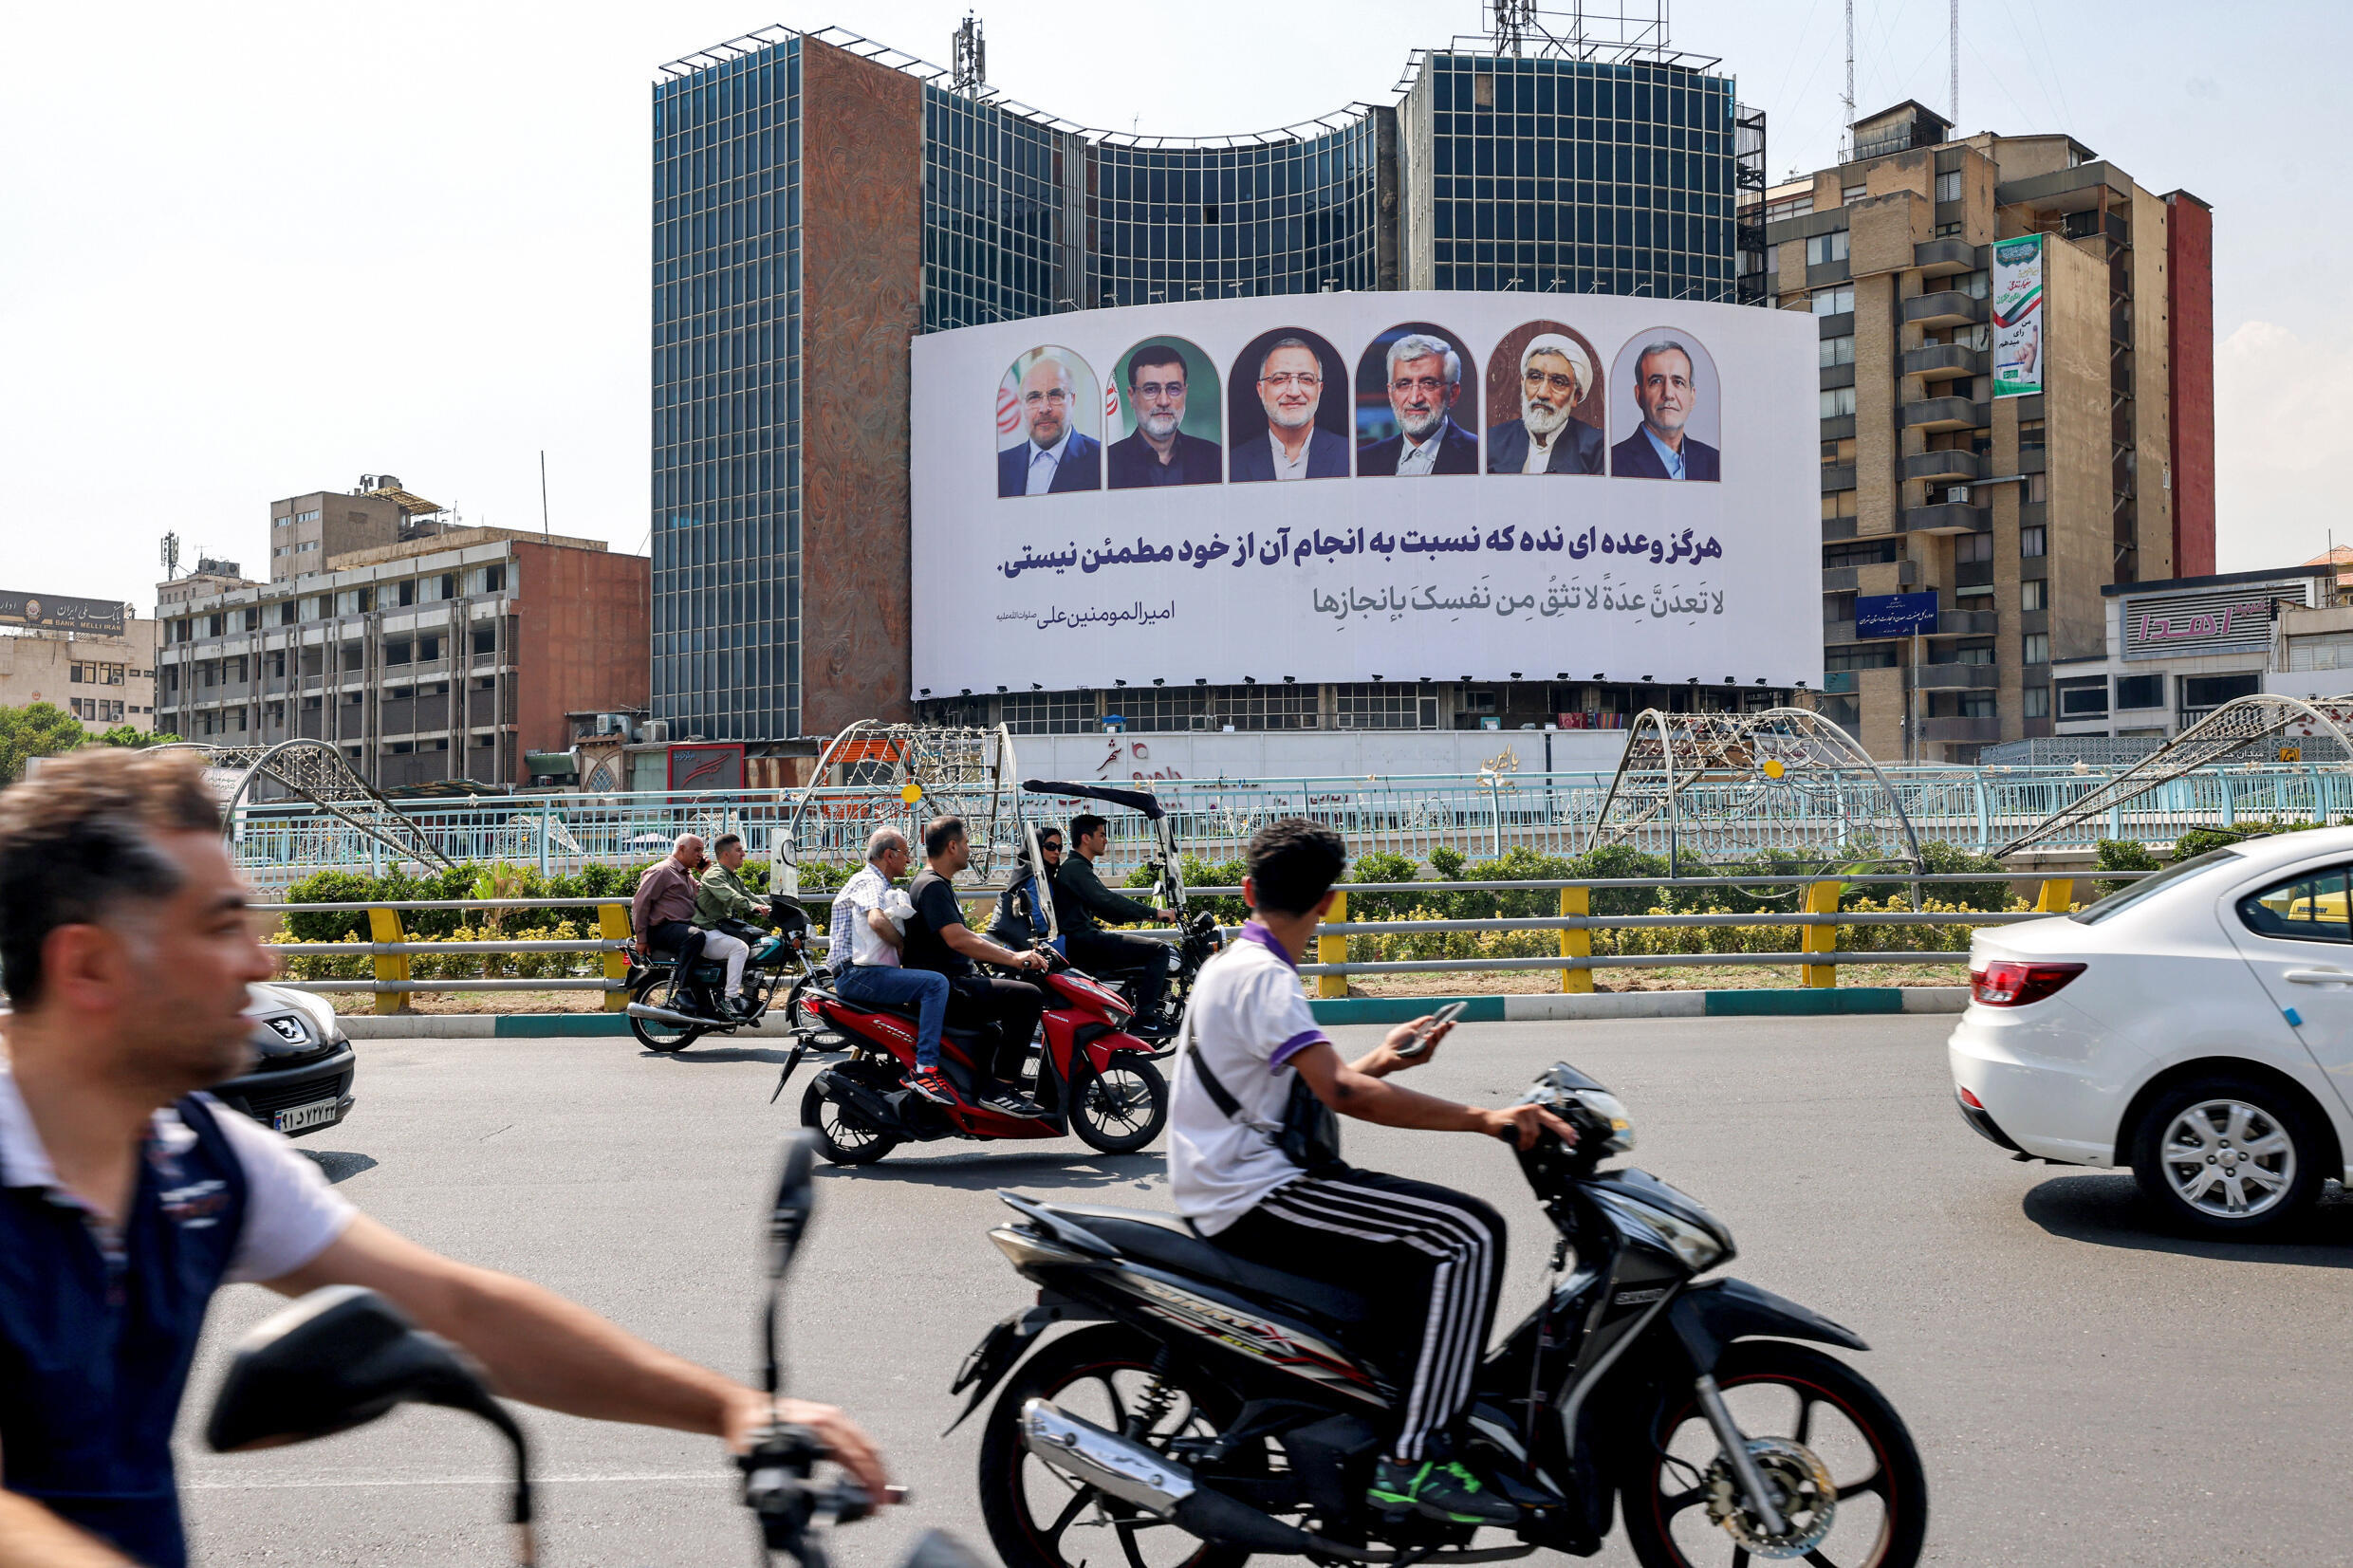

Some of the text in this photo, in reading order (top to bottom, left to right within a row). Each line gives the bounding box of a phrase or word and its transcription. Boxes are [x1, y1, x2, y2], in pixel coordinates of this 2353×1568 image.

[996, 524, 1723, 580] هرگز وعده ای نده که نسبت به انجام آن از خود مطمئن نیستی.
[56, 604, 78, 620] ایران
[88, 604, 124, 625] بانک
[1711, 589, 1724, 616] لا
[55, 618, 76, 628] BANK
[80, 621, 102, 630] MELLI
[2138, 606, 2233, 642] اهدا
